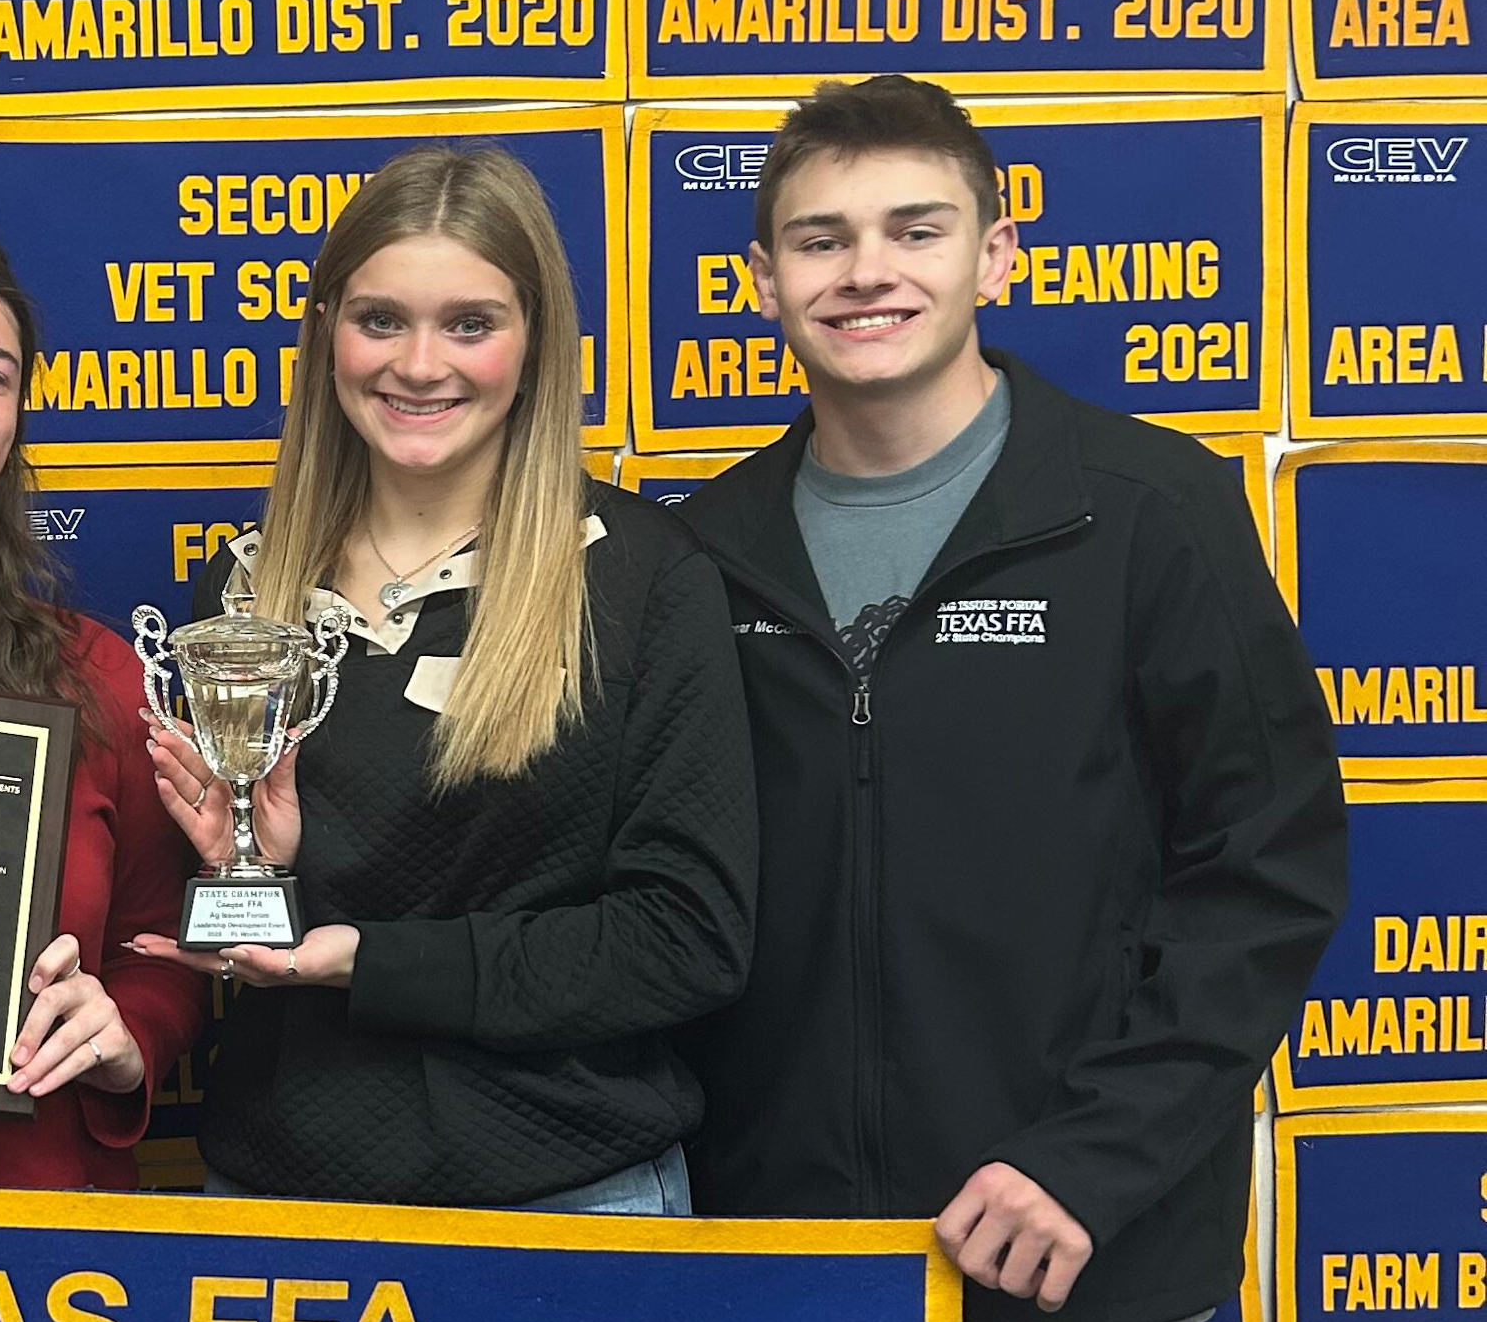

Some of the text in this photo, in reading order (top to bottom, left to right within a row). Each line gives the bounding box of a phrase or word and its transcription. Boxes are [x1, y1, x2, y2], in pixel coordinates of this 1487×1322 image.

[1326, 138, 1468, 173] CEV
[1333, 174, 1457, 183] MULTIMEDIA
[1125, 322, 1249, 382] 2021
[1325, 325, 1463, 384] AREA
[938, 600, 1048, 612] AG ISSUES FORUM
[936, 614, 1046, 632] TEXAS FFA
[981, 632, 1046, 643] Champions
[1322, 1253, 1439, 1312] FARM
